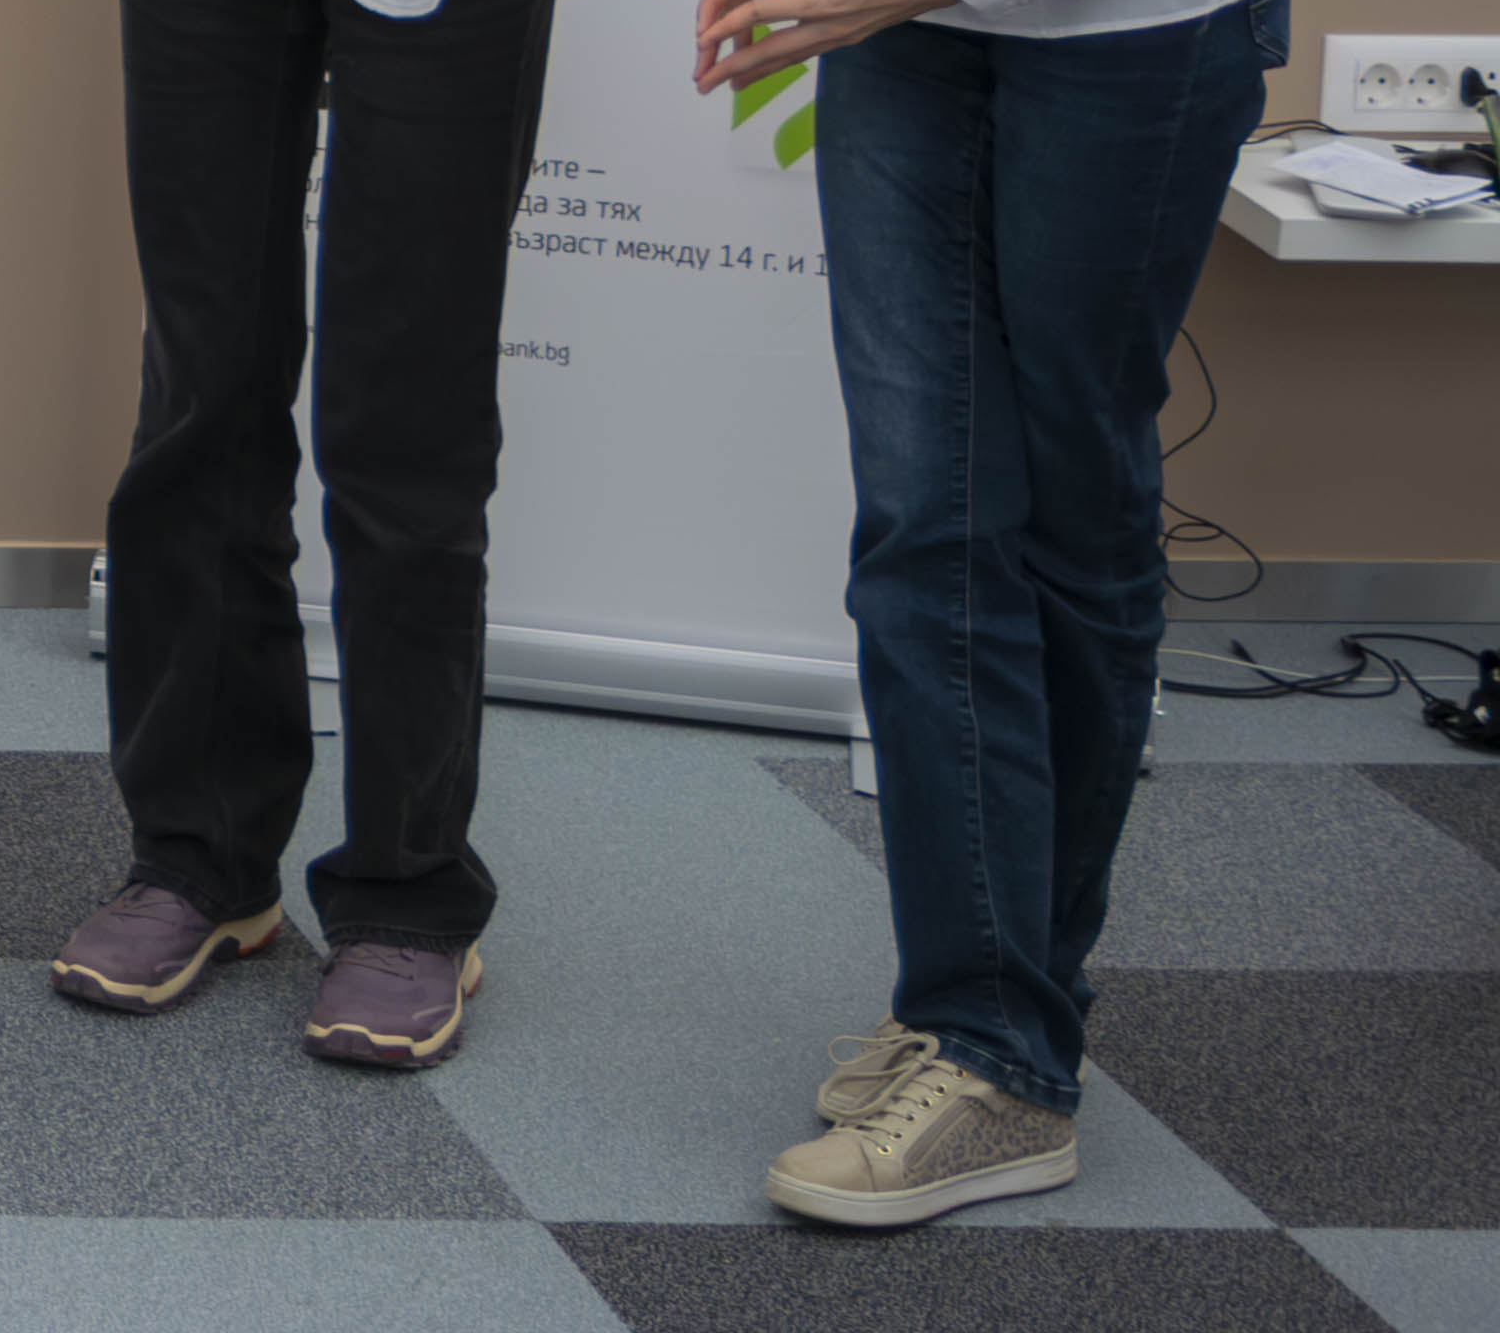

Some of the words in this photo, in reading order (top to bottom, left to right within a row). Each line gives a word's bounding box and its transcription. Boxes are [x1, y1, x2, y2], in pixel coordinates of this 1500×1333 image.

[555, 197, 587, 218] за
[596, 200, 642, 223] тях
[616, 239, 711, 271] между
[719, 244, 753, 269] 14
[788, 255, 805, 275] и
